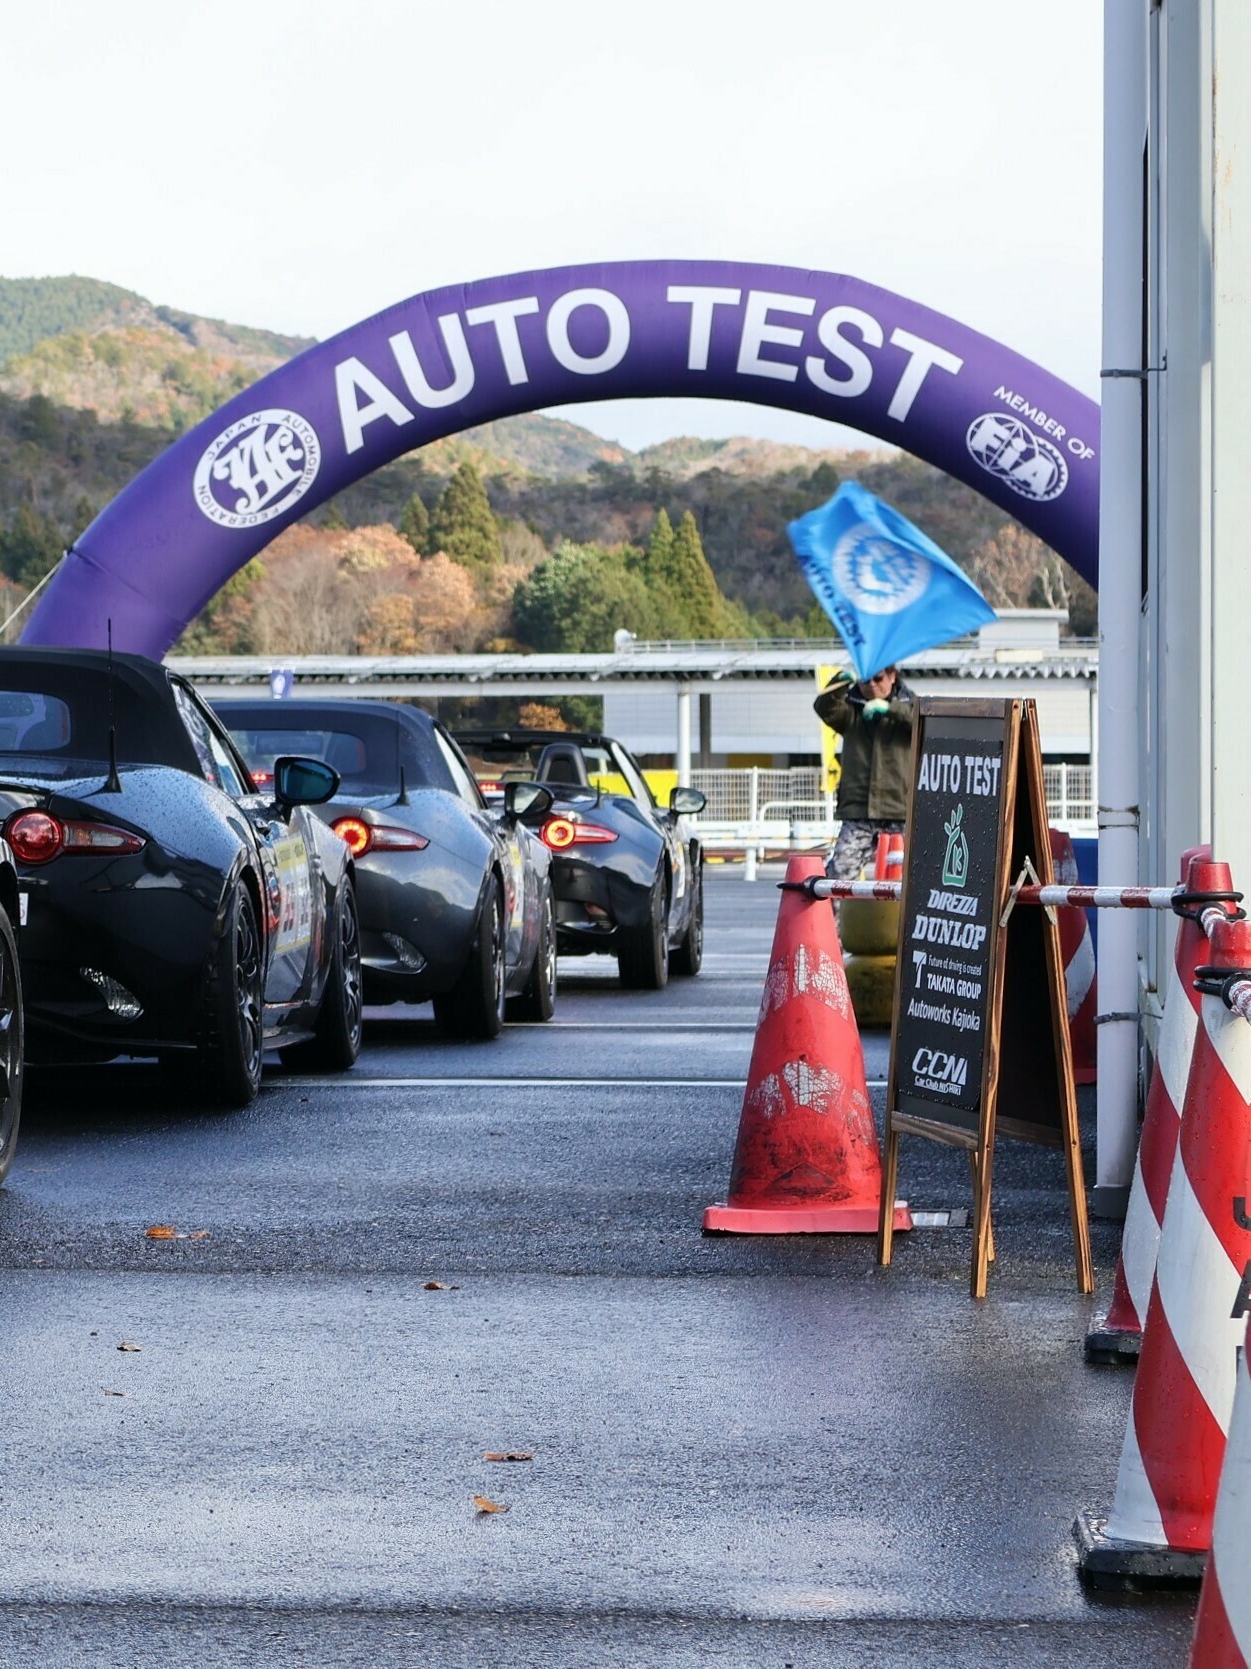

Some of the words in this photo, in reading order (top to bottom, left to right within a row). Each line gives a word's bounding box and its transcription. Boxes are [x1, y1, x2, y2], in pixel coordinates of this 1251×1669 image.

[334, 288, 631, 455] AUTO
[666, 286, 964, 423] TEST
[207, 414, 262, 461] JAPAN
[993, 385, 1067, 441] MEMBER
[1067, 437, 1096, 460] OF
[281, 414, 318, 497] AUTOMOBILE
[198, 484, 280, 526] FEDERATION
[917, 753, 962, 794] AUTO
[964, 755, 1002, 797] TEST
[927, 889, 979, 916] DIREZZA
[911, 914, 987, 950] DUNLOP
[929, 954, 943, 968] Future
[966, 963, 982, 976] created
[927, 973, 955, 995] TAKATA
[956, 979, 982, 999] GROUP
[907, 998, 952, 1025] Autoworks
[951, 1007, 981, 1032] Kajioka
[914, 1075, 926, 1087] Car
[925, 1078, 939, 1090] Club
